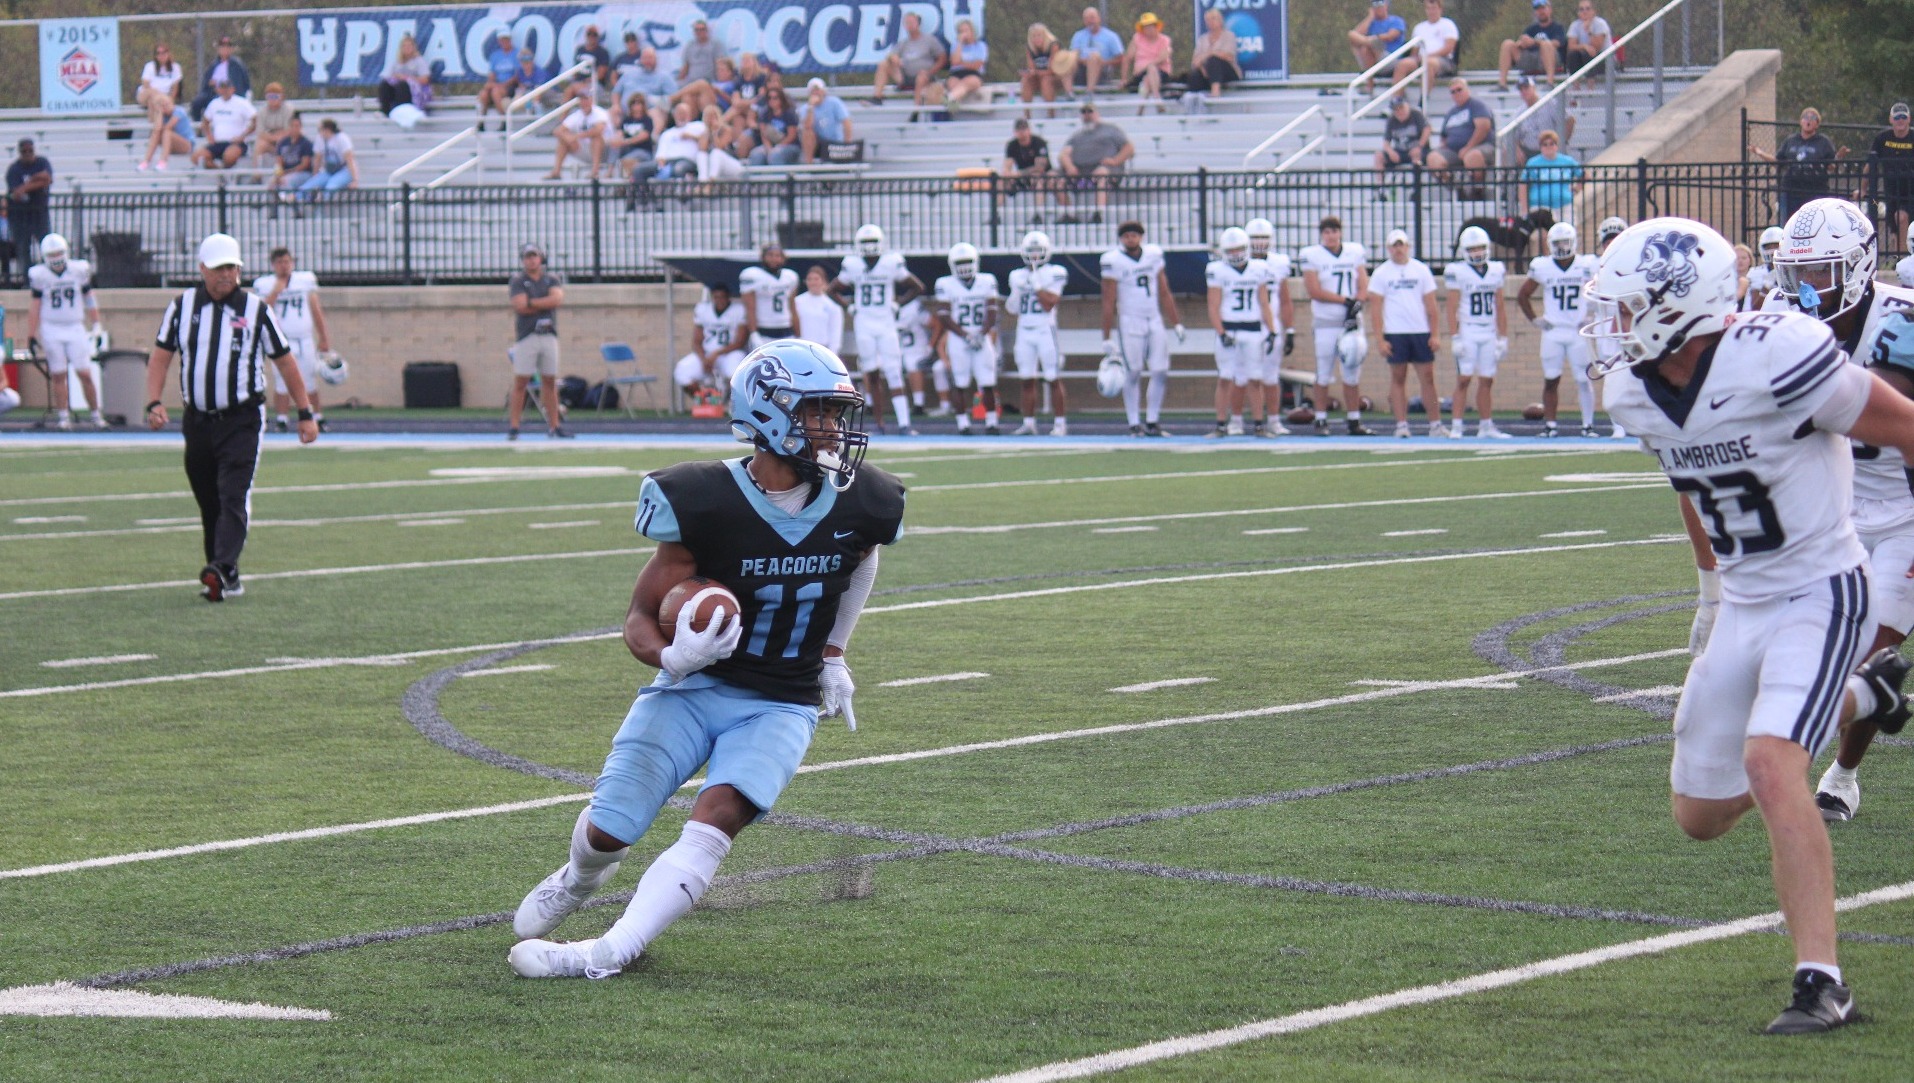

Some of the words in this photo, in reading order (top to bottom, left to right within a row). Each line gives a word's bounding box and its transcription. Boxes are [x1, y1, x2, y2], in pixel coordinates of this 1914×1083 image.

[58, 25, 99, 43] 2015
[60, 60, 98, 77] MIAA
[47, 99, 114, 111] CHAMPIONS
[1789, 247, 1813, 255] Riddell
[1137, 274, 1150, 297] 9
[1332, 271, 1352, 295] 71
[773, 292, 784, 313] 6
[862, 284, 885, 306] 83
[1232, 288, 1253, 311] 31
[1470, 292, 1494, 316] 80
[1552, 285, 1580, 310] 42
[277, 297, 303, 318] 74
[959, 303, 983, 326] 26
[1671, 434, 1758, 470] AMBROSE
[635, 498, 657, 537] 11
[1669, 470, 1786, 556] 33
[740, 554, 842, 577] PEACOCKS
[746, 582, 823, 658] 11
